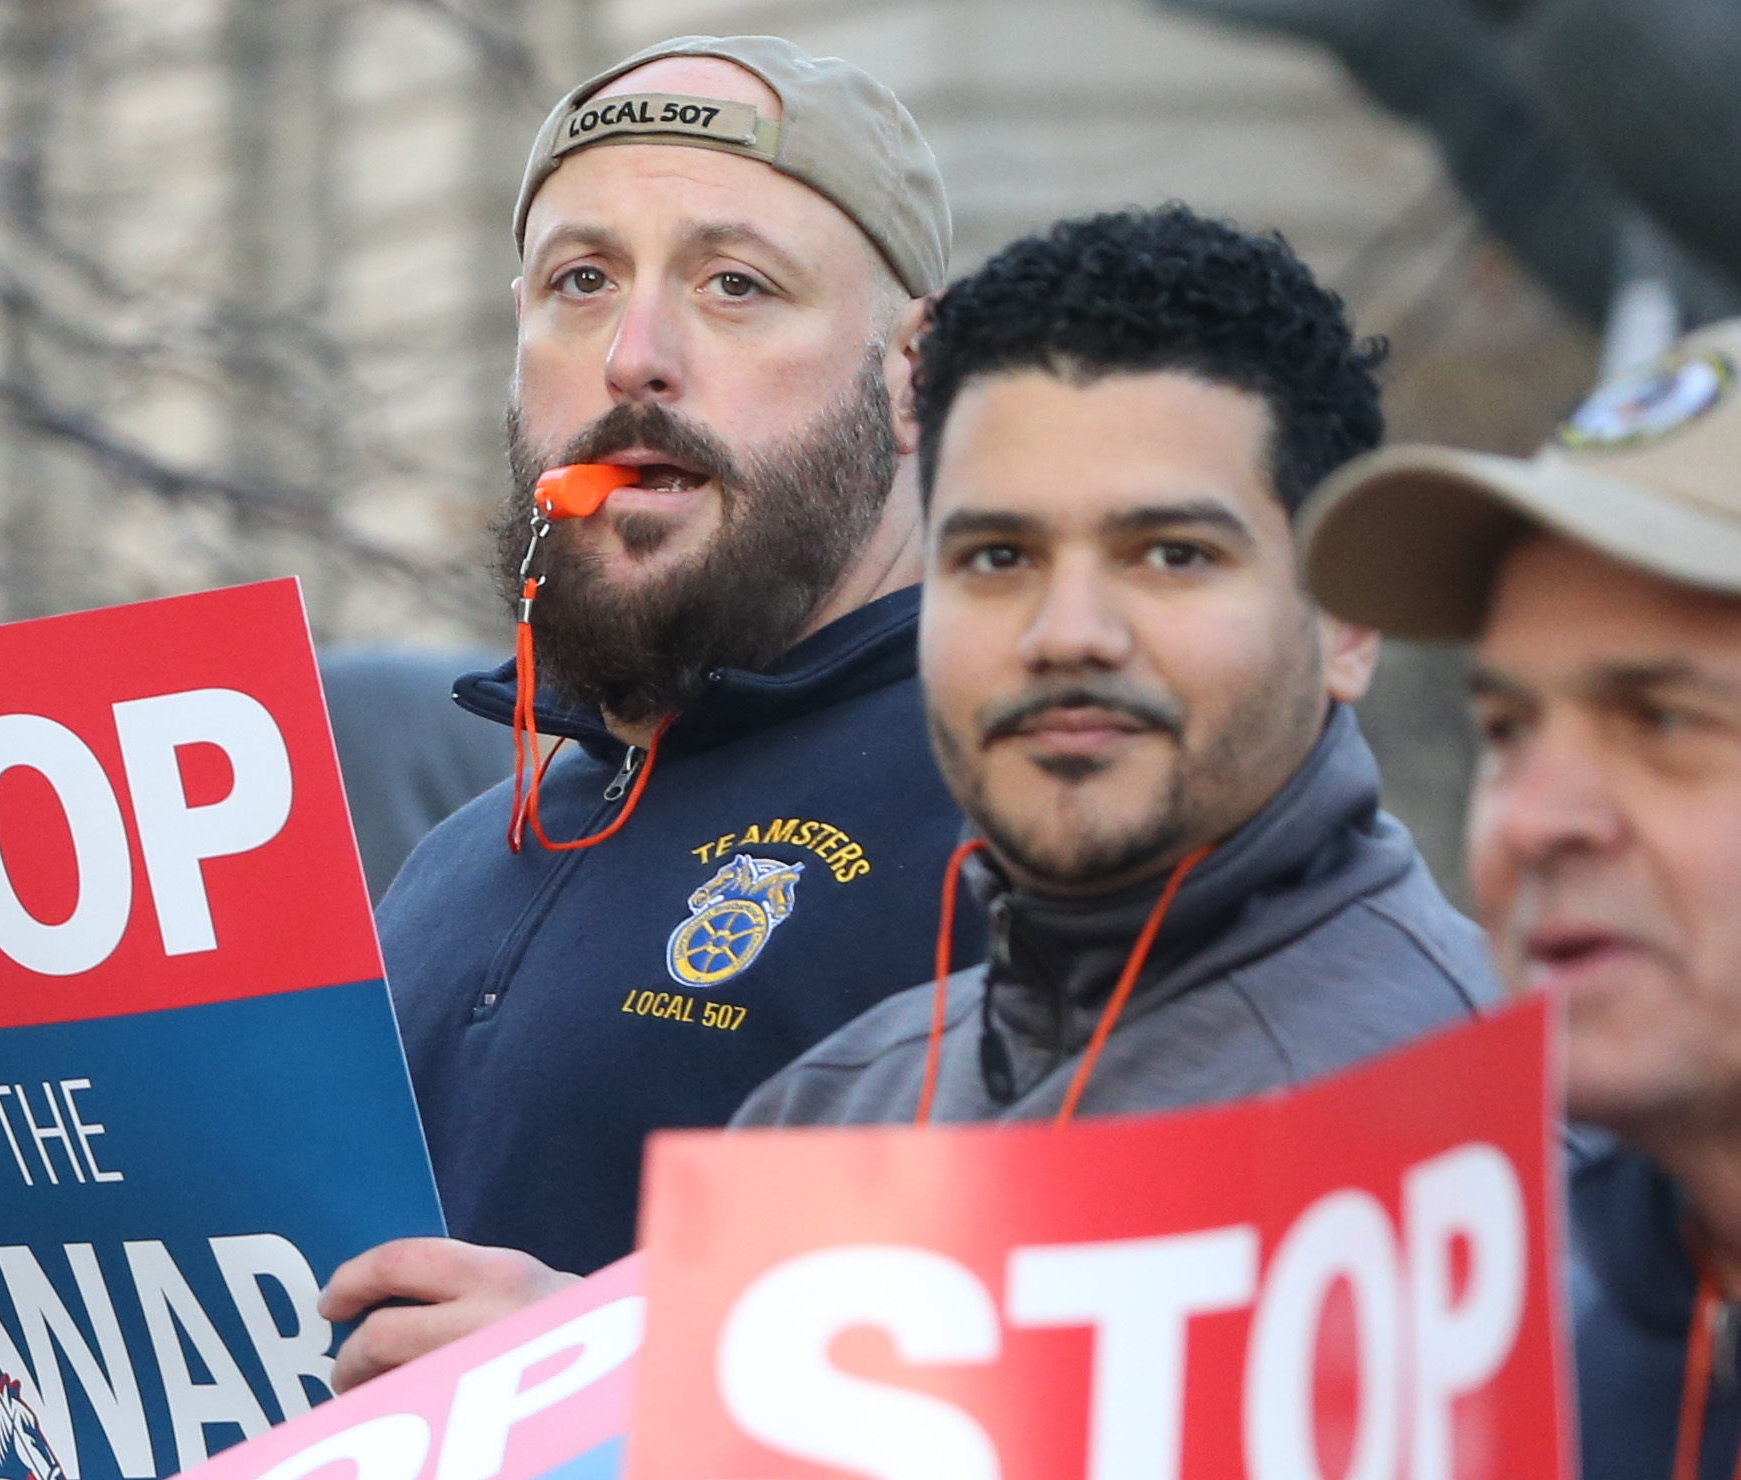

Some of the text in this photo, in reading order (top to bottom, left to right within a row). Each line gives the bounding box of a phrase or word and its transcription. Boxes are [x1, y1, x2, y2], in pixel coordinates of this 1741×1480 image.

[569, 101, 720, 137] LOCAL 507
[691, 818, 871, 883] TEAMSTERS
[621, 989, 748, 1031] LOCAL 507
